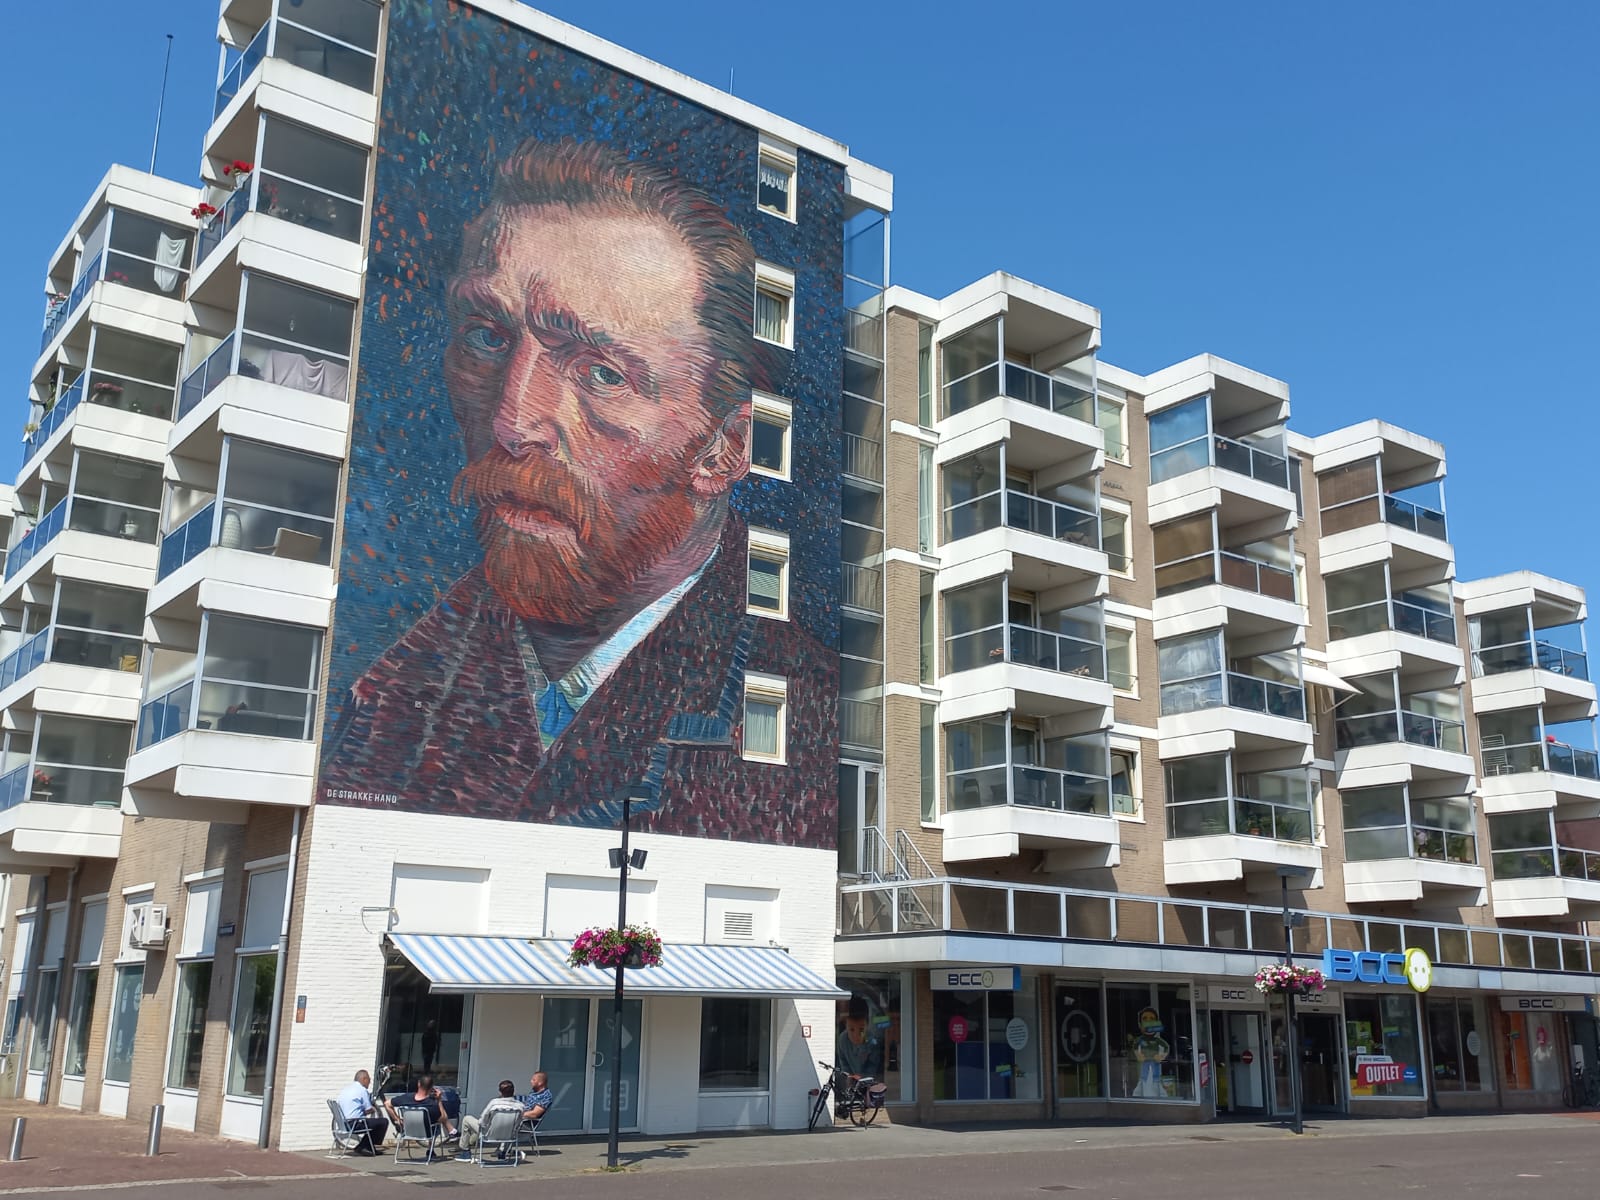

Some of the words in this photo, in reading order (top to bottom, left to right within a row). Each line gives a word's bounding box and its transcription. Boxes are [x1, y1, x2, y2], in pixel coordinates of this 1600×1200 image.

[327, 788, 337, 798] DE
[338, 790, 373, 802] STRAKKE
[374, 793, 397, 804] HAND
[1323, 948, 1408, 985] BCC
[948, 973, 982, 986] BCC
[1221, 990, 1246, 1000] BCC
[1518, 999, 1554, 1009] BCC
[1365, 1065, 1400, 1083] OUTLET
